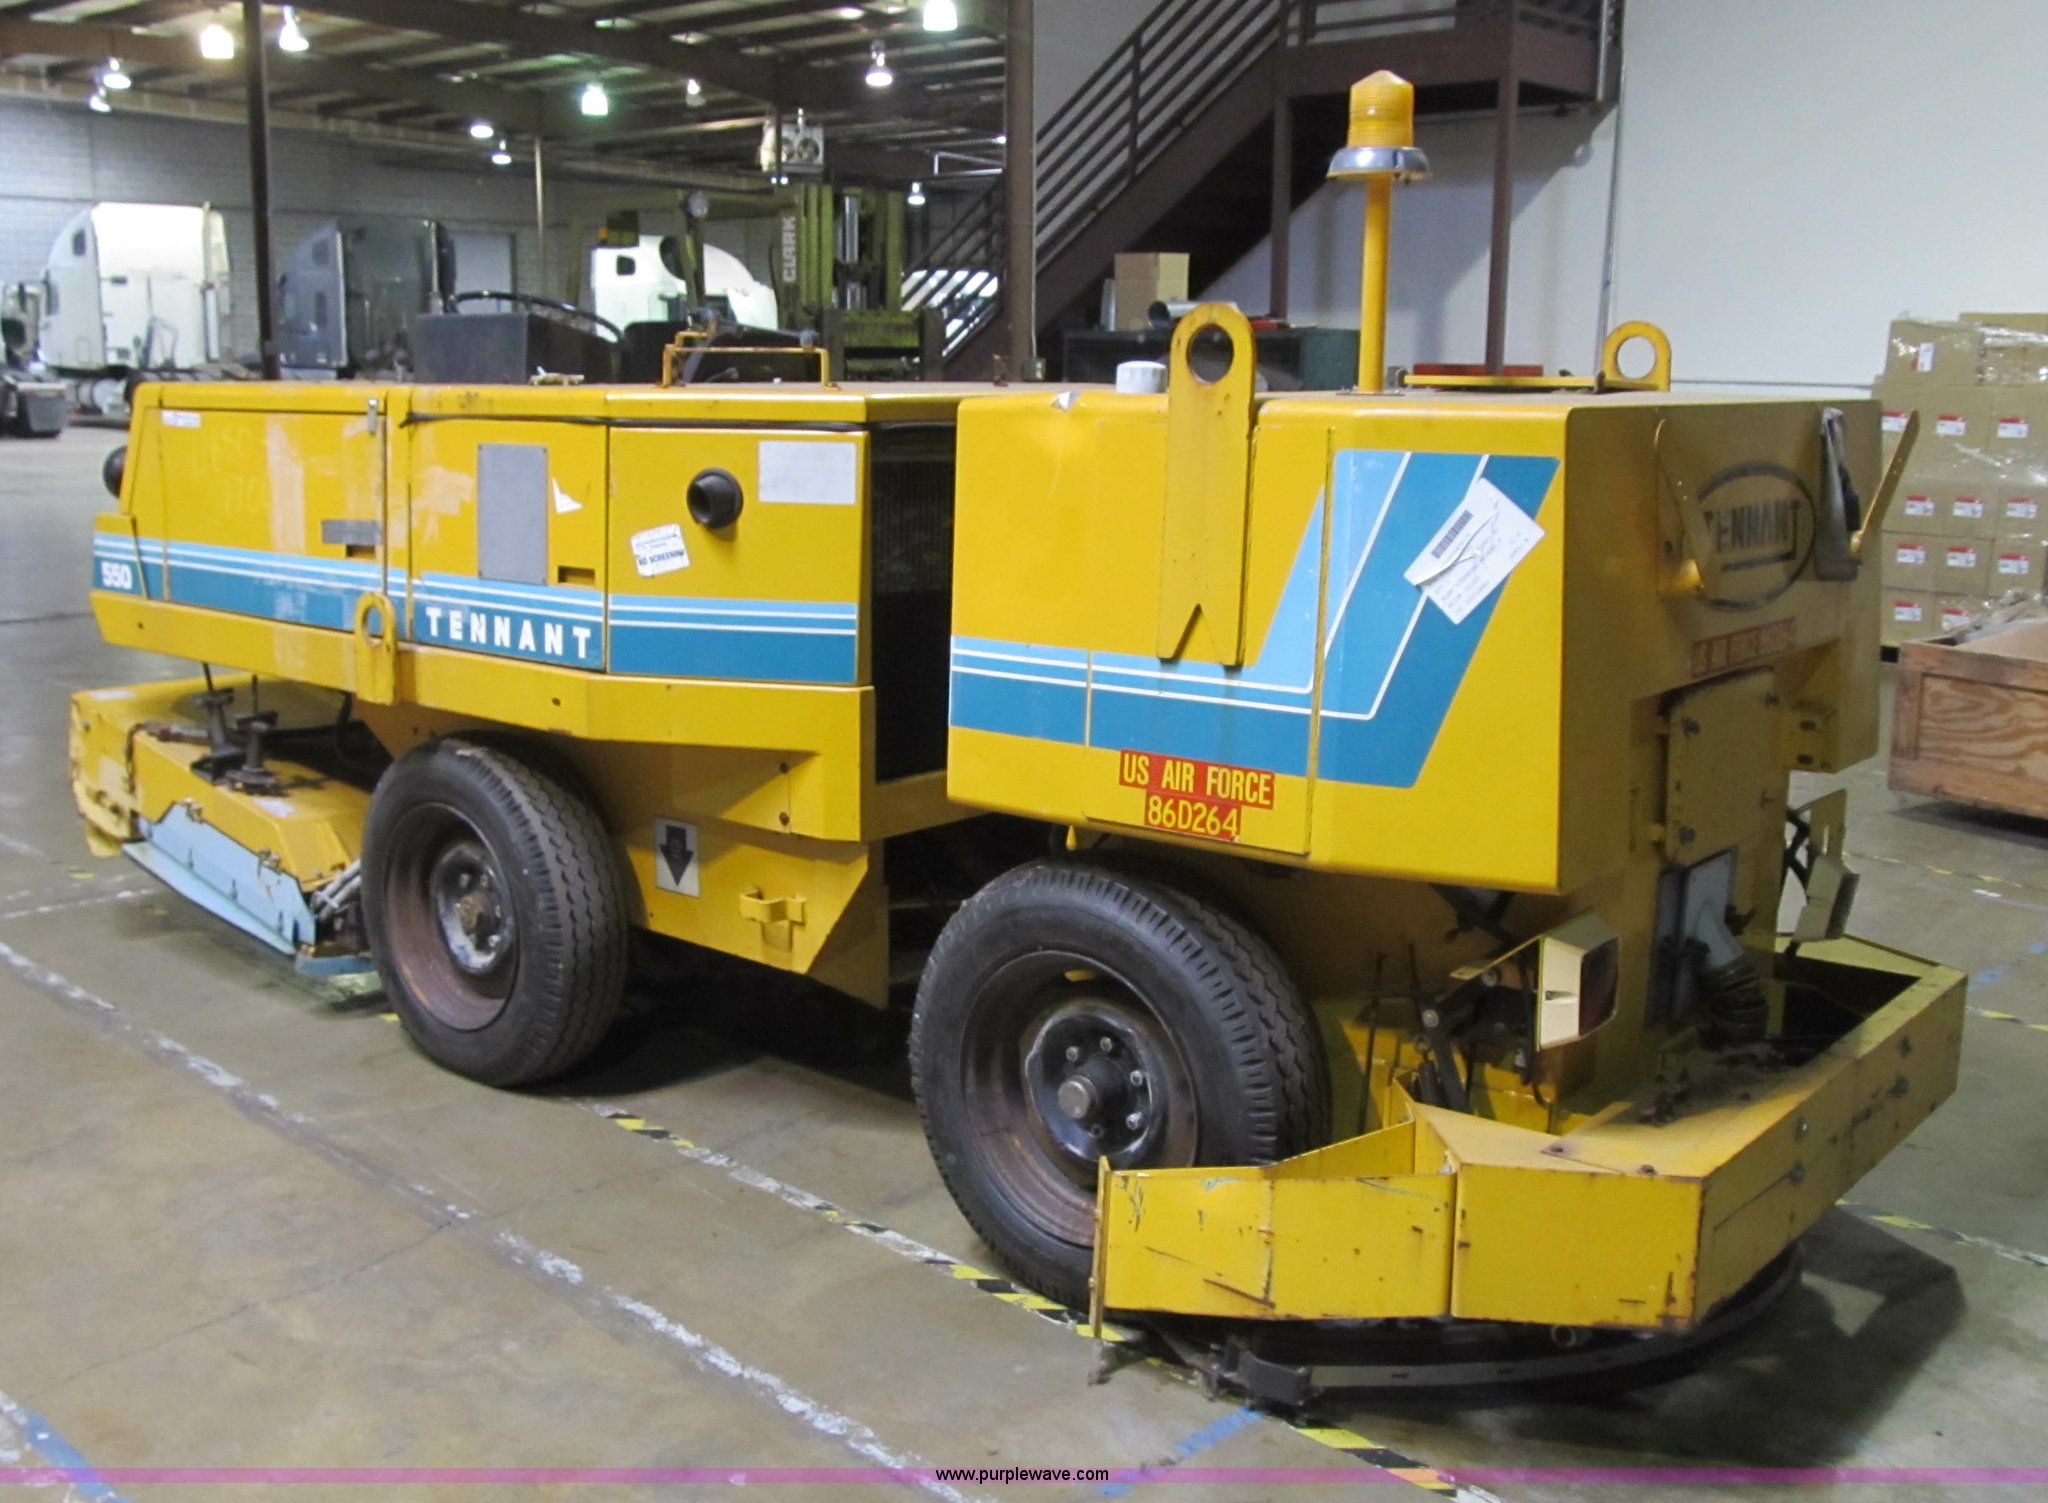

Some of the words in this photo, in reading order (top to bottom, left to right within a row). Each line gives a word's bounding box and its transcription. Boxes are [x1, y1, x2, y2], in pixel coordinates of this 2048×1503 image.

[783, 215, 796, 282] CLARK
[101, 561, 133, 590] 550
[425, 606, 592, 659] TENNANT
[1123, 753, 1150, 786] US
[1161, 759, 1195, 794] AIR
[1206, 766, 1272, 805] FORCE
[1147, 795, 1238, 836] 86D264
